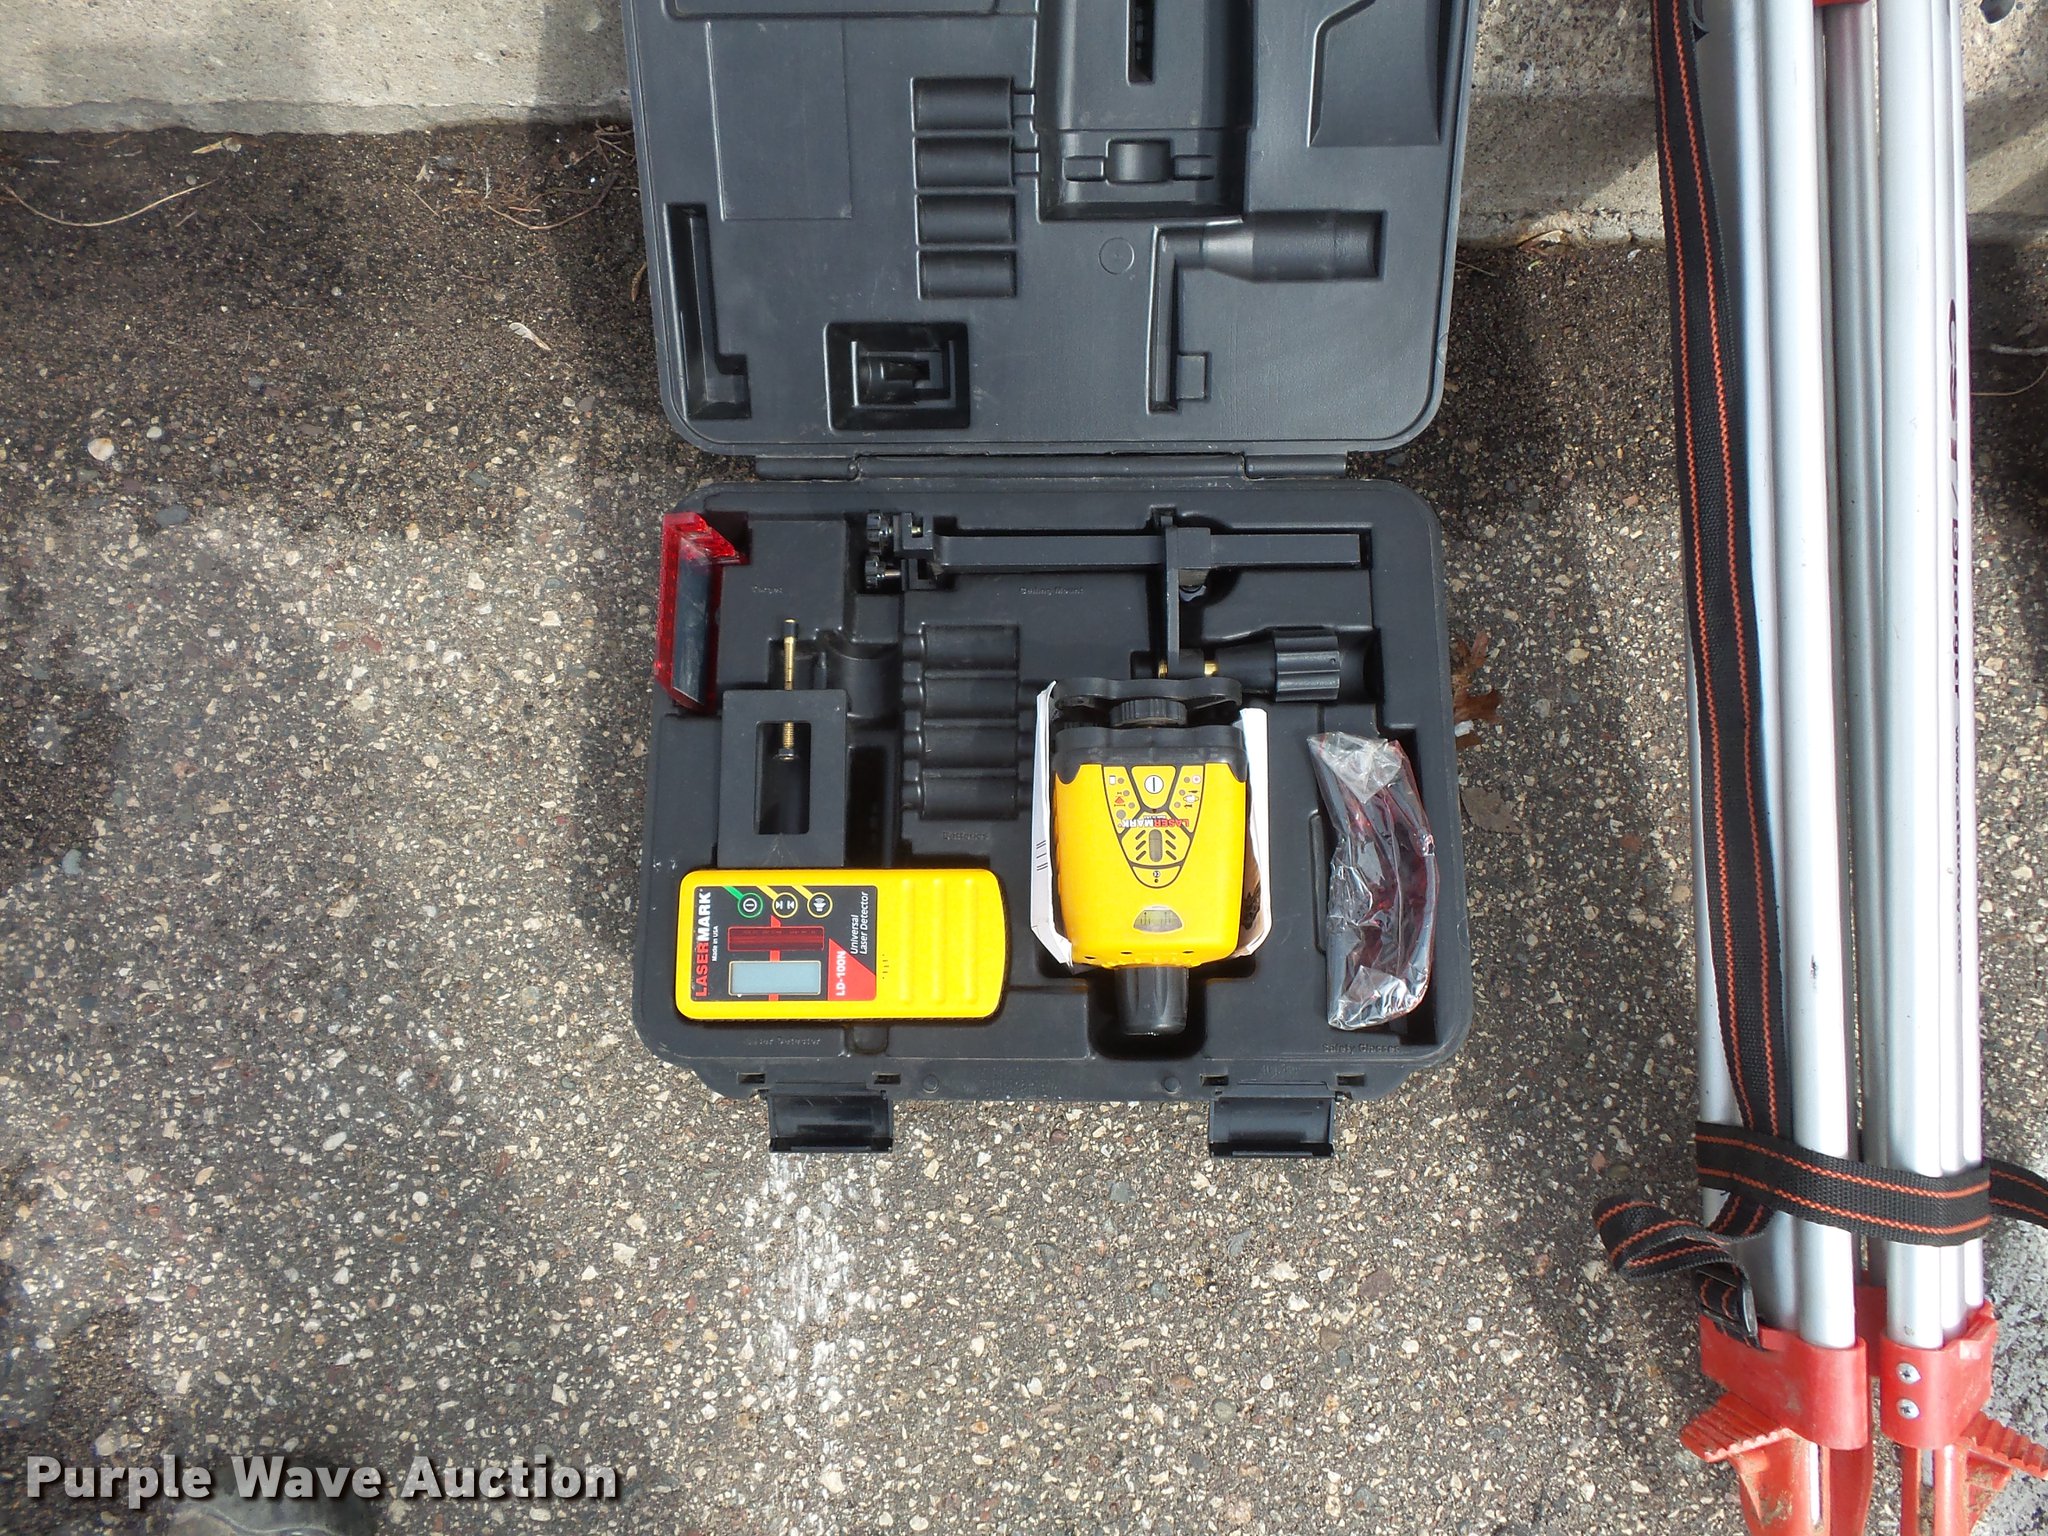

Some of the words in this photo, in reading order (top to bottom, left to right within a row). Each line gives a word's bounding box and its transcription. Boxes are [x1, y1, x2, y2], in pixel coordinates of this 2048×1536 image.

[1121, 818, 1189, 828] LASERMARK
[860, 891, 869, 931] Detector
[696, 891, 712, 997] LASERMARK
[850, 914, 859, 955] Universal
[859, 932, 868, 955] Laser
[836, 950, 846, 996] LD-100N
[1322, 1043, 1356, 1055] Safety
[1359, 1043, 1401, 1053] Glasses
